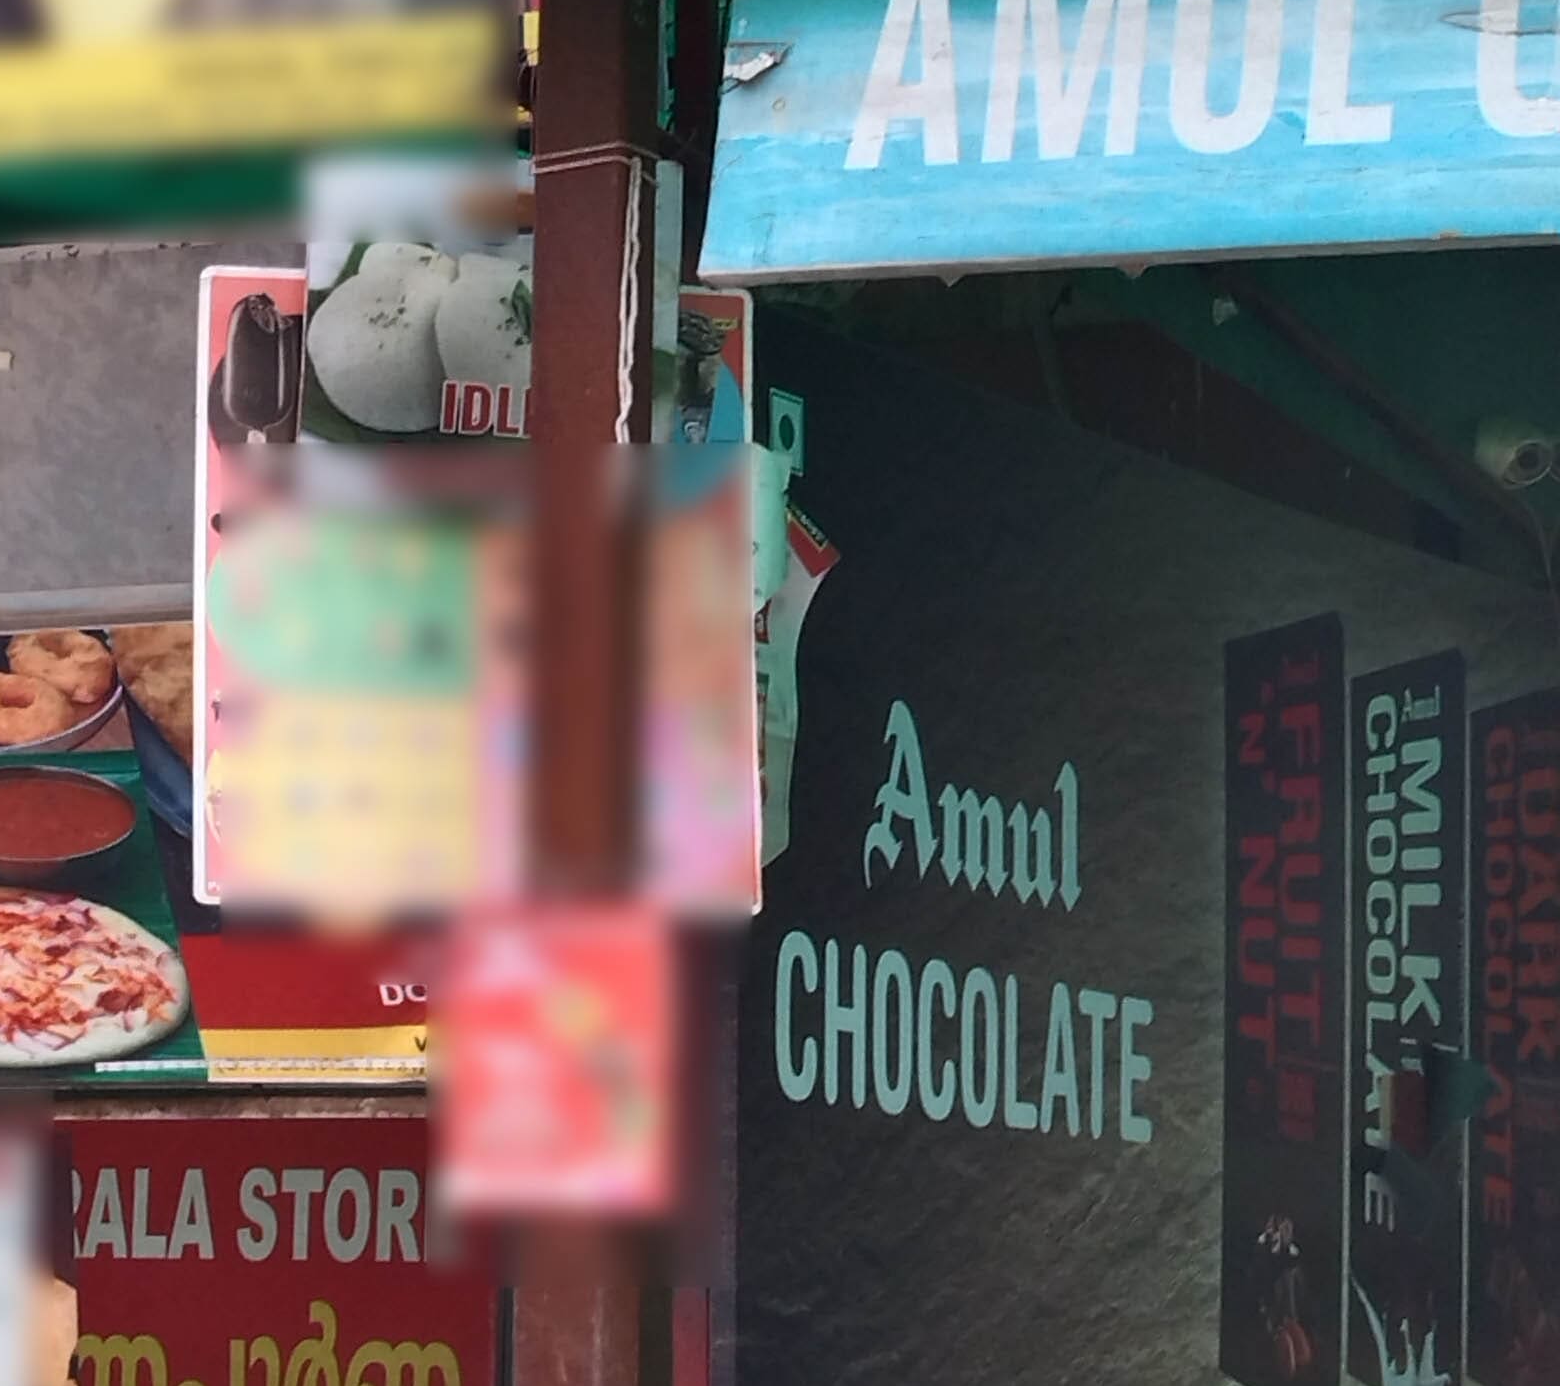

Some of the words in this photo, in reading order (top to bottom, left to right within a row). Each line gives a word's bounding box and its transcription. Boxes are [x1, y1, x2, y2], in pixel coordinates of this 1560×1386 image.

[863, 700, 1081, 911] Amul
[1281, 703, 1321, 1046] FRUIT
[1400, 737, 1440, 1026] MILK
[776, 931, 1154, 1143] CHOCOLATE
[1239, 835, 1276, 1068] NUT
